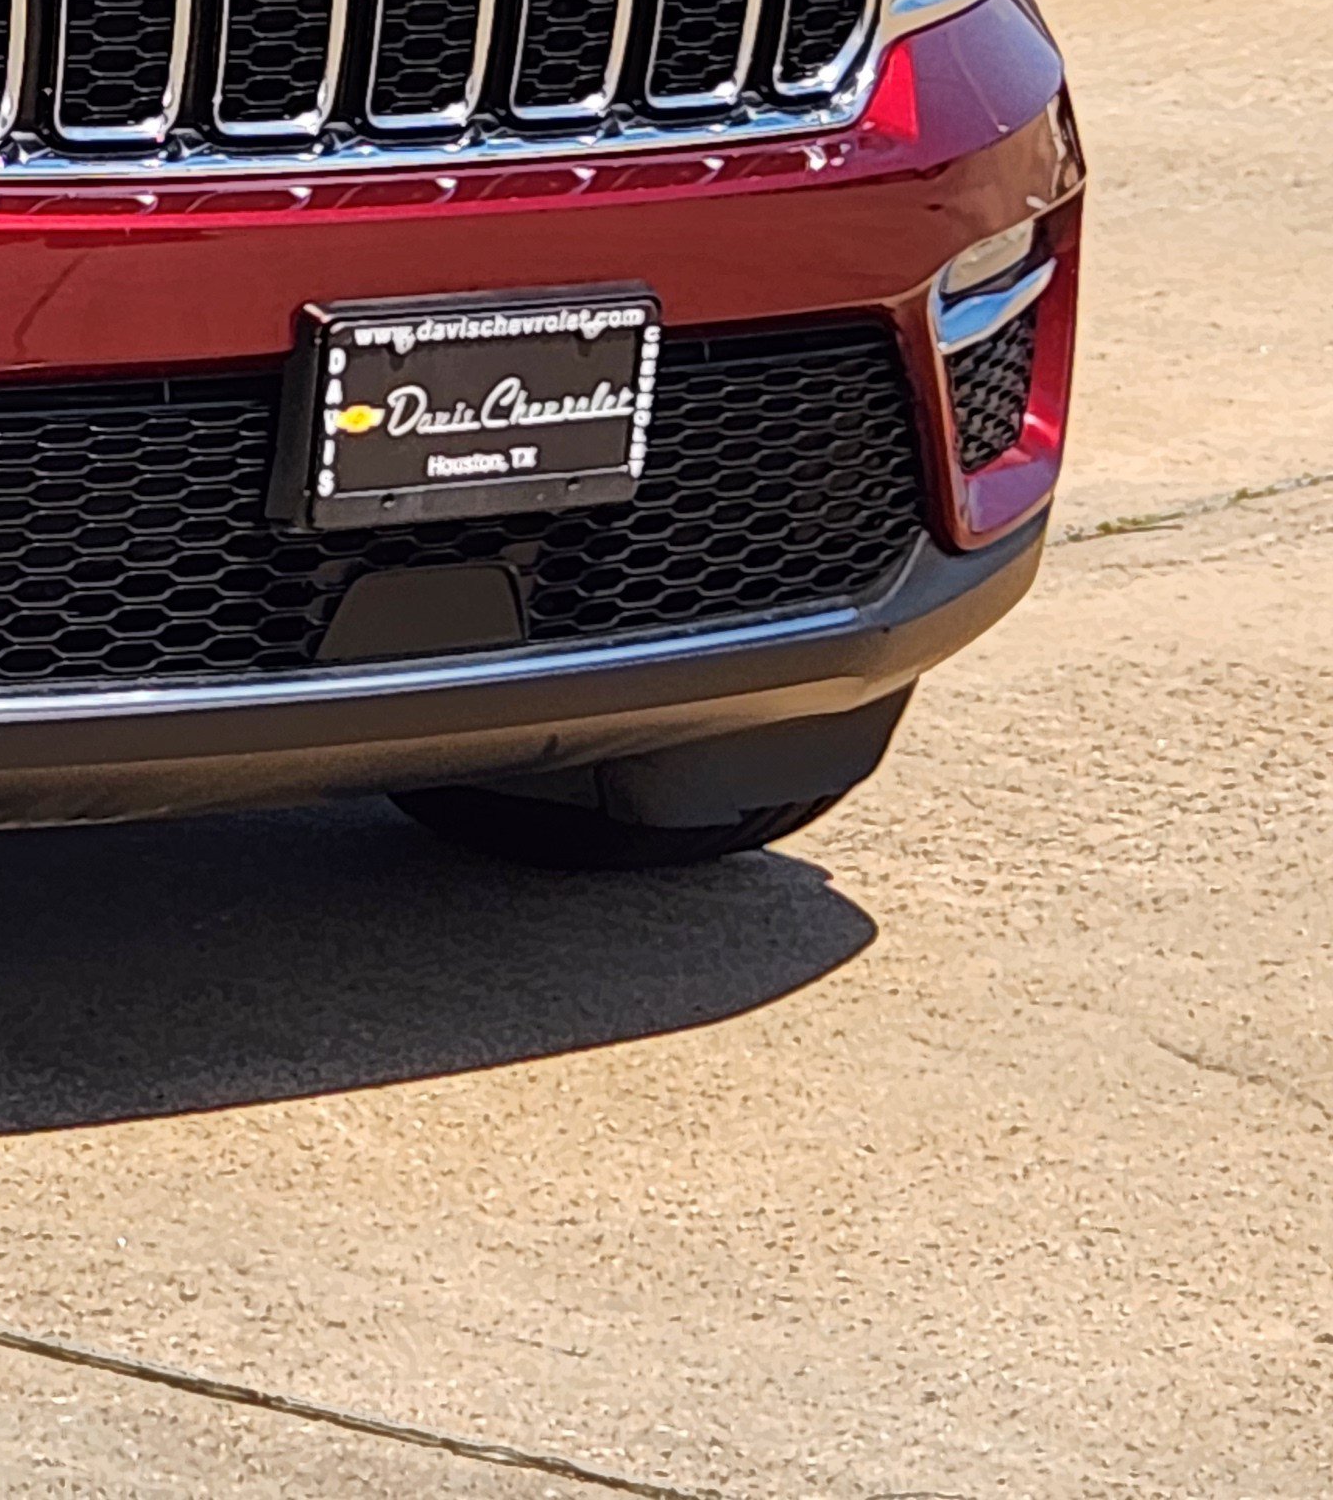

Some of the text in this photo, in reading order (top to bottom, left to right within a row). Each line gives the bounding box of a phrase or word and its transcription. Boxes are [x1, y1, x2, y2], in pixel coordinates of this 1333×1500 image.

[354, 308, 646, 348] www.davischevrolet.com
[317, 347, 347, 497] DAVIS
[386, 376, 635, 437] Davis Chevrolet
[508, 446, 539, 469] TX
